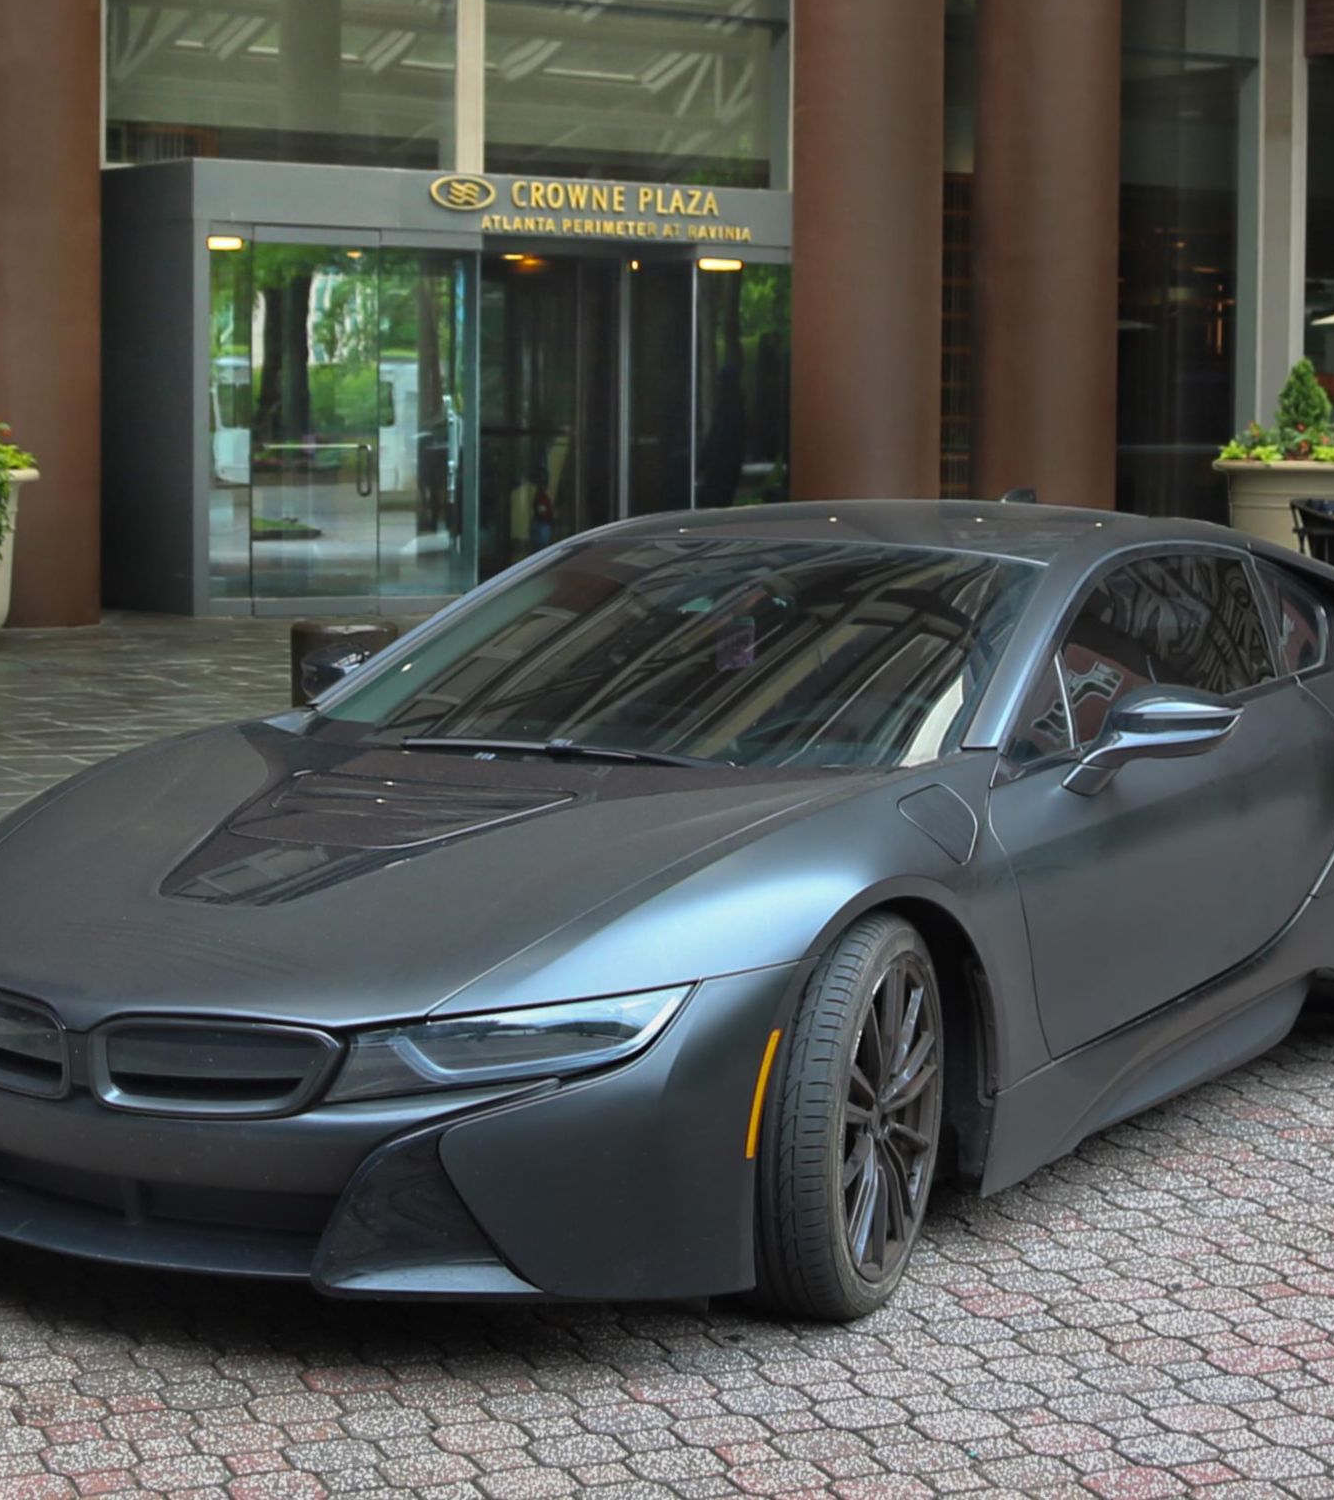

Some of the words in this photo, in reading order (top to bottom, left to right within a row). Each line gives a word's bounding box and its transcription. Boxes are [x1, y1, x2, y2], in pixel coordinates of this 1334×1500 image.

[511, 180, 626, 212] CROWNE
[638, 186, 720, 217] PLAZA
[481, 214, 556, 233] ATLANTA
[561, 217, 657, 238] PERIMETER
[662, 223, 681, 239] AT
[687, 224, 752, 242] RAVINIA
